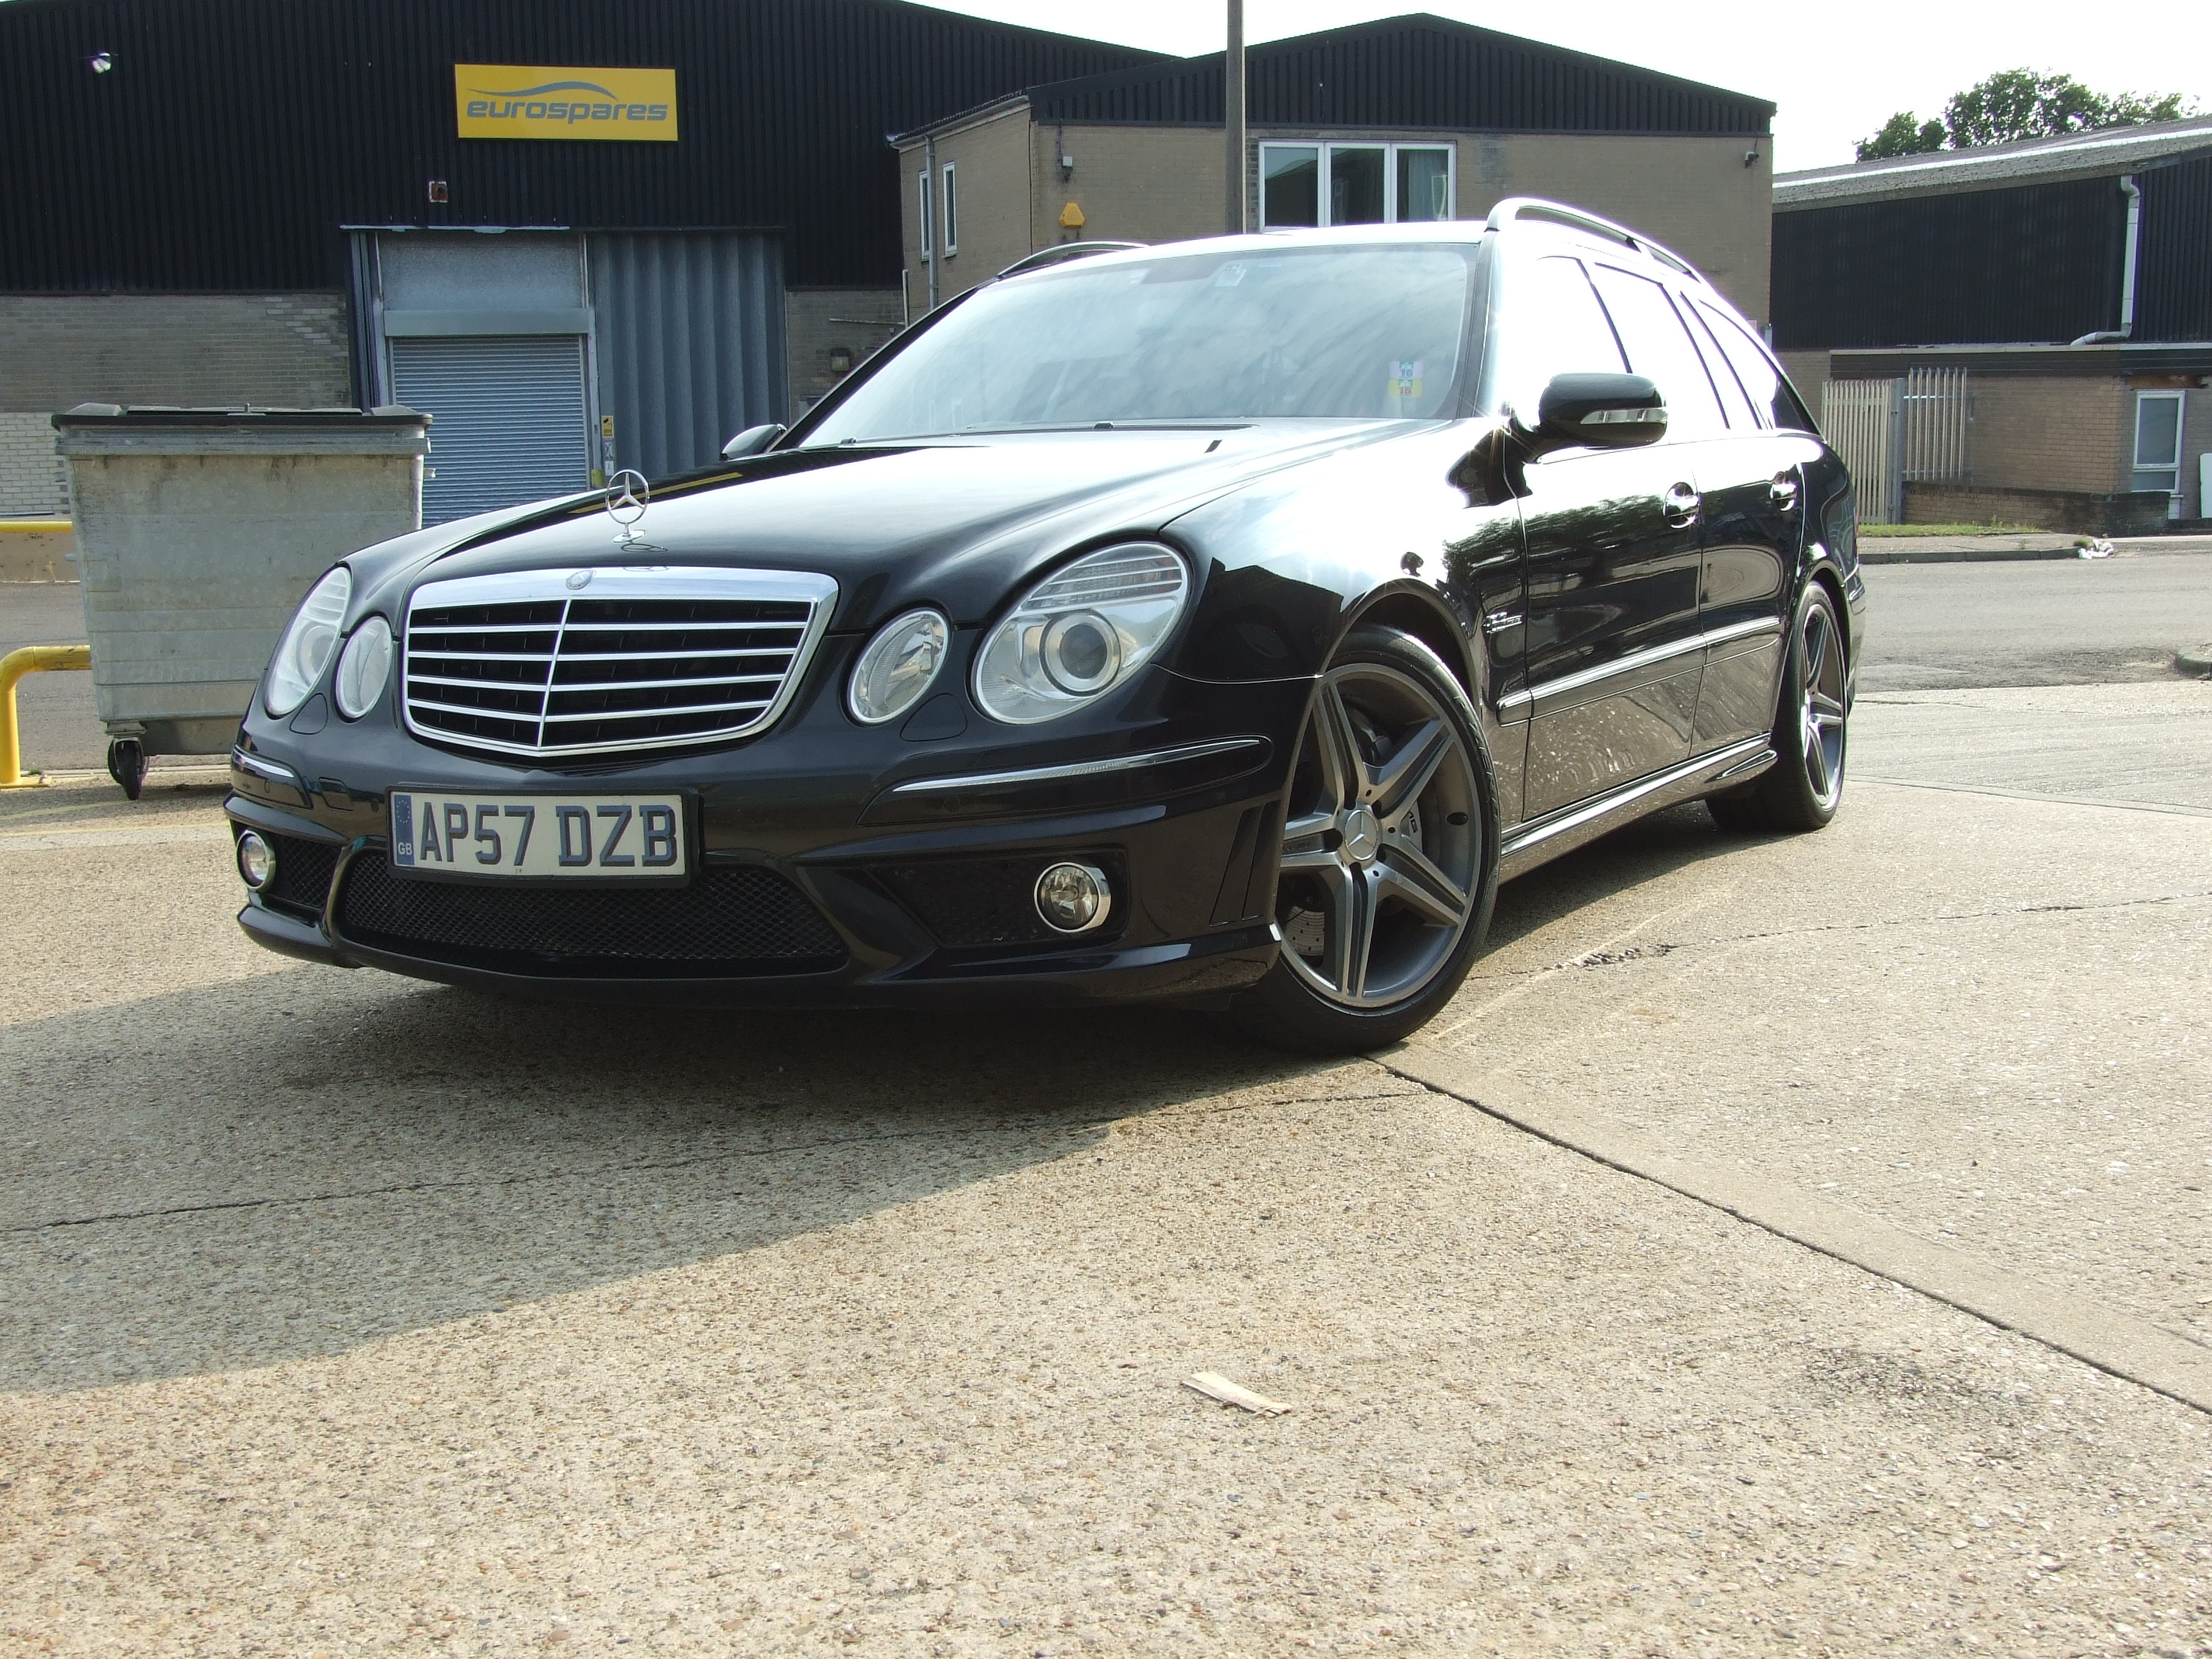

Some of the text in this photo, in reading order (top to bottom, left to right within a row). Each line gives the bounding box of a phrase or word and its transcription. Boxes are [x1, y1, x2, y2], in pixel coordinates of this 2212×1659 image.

[467, 100, 668, 124] eurospares
[420, 802, 678, 868] AP57 DZB
[398, 842, 413, 855] GB
